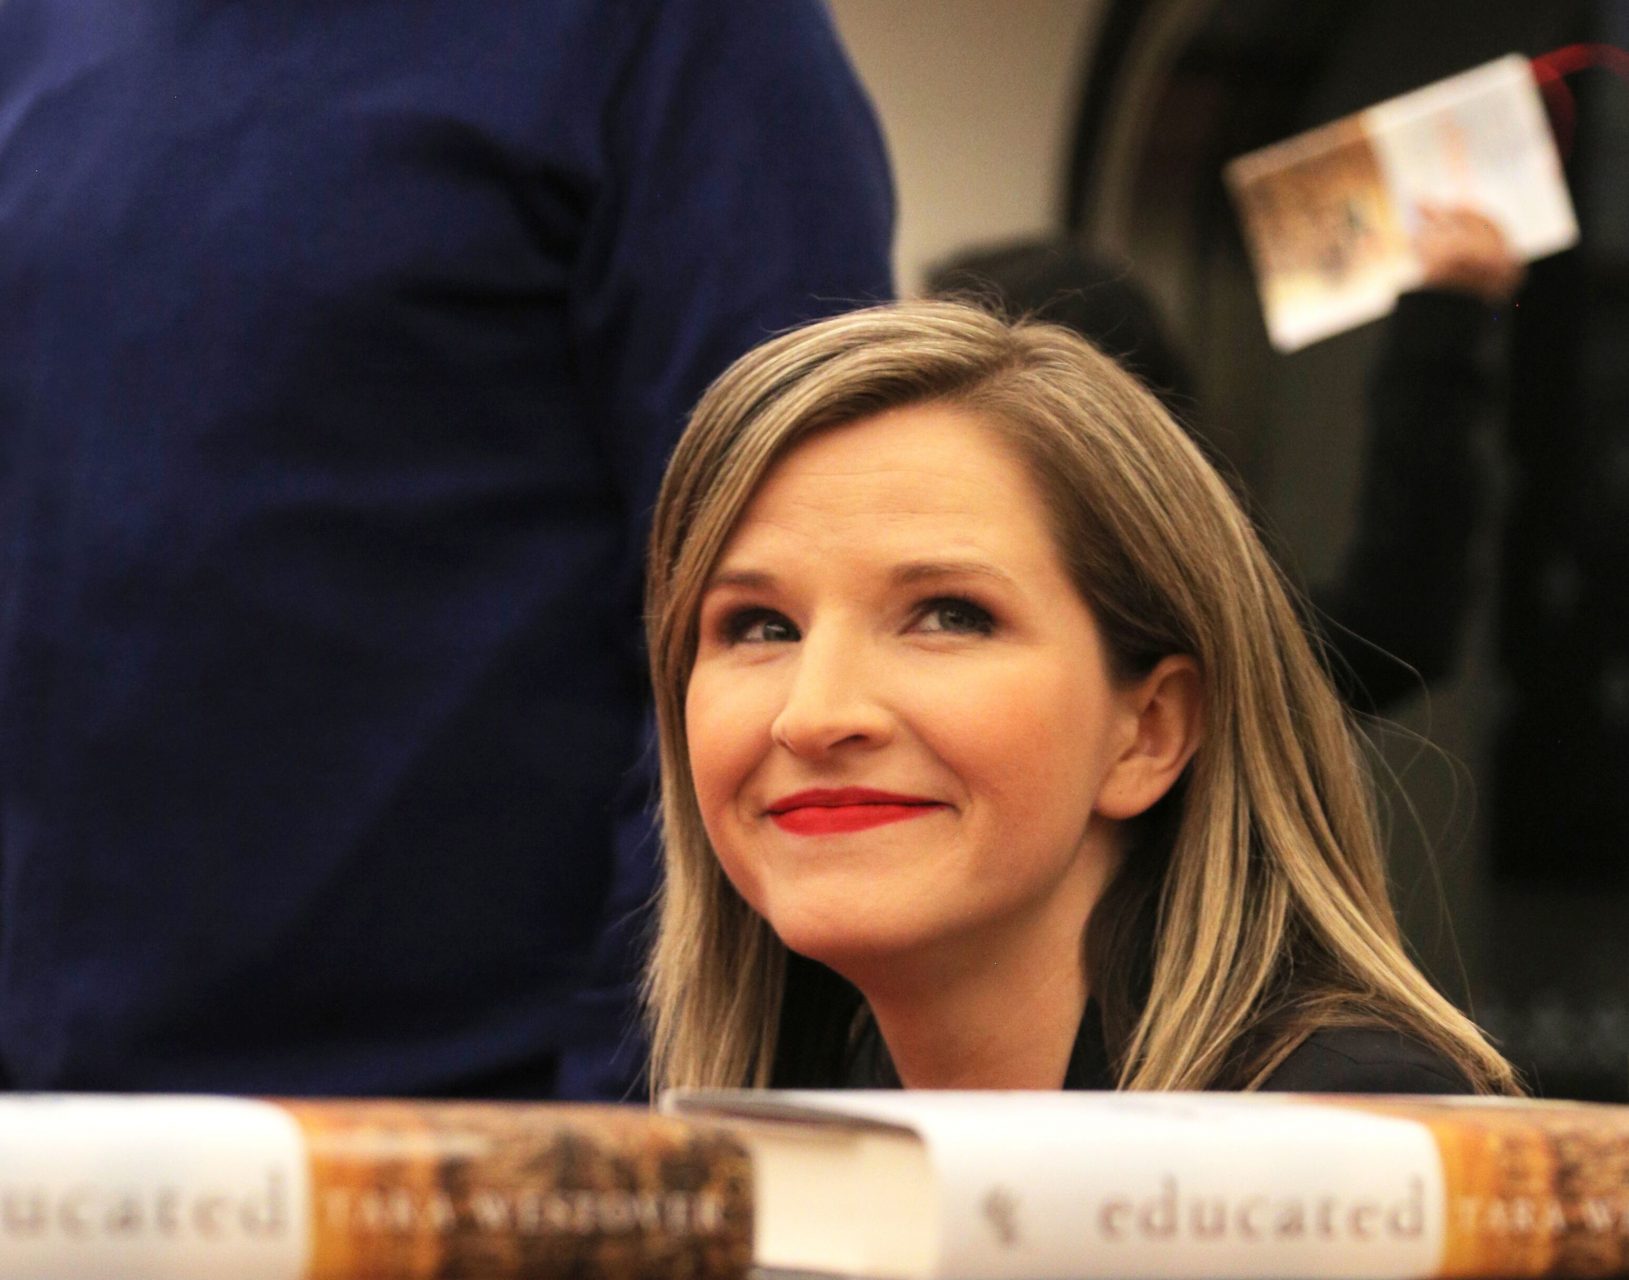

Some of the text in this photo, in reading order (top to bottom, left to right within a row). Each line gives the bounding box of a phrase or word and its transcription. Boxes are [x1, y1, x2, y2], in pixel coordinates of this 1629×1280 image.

[1, 1166, 723, 1241] ucated TARA WESTOVER
[1099, 1172, 1425, 1243] educated
[1457, 1196, 1568, 1236] TARA
